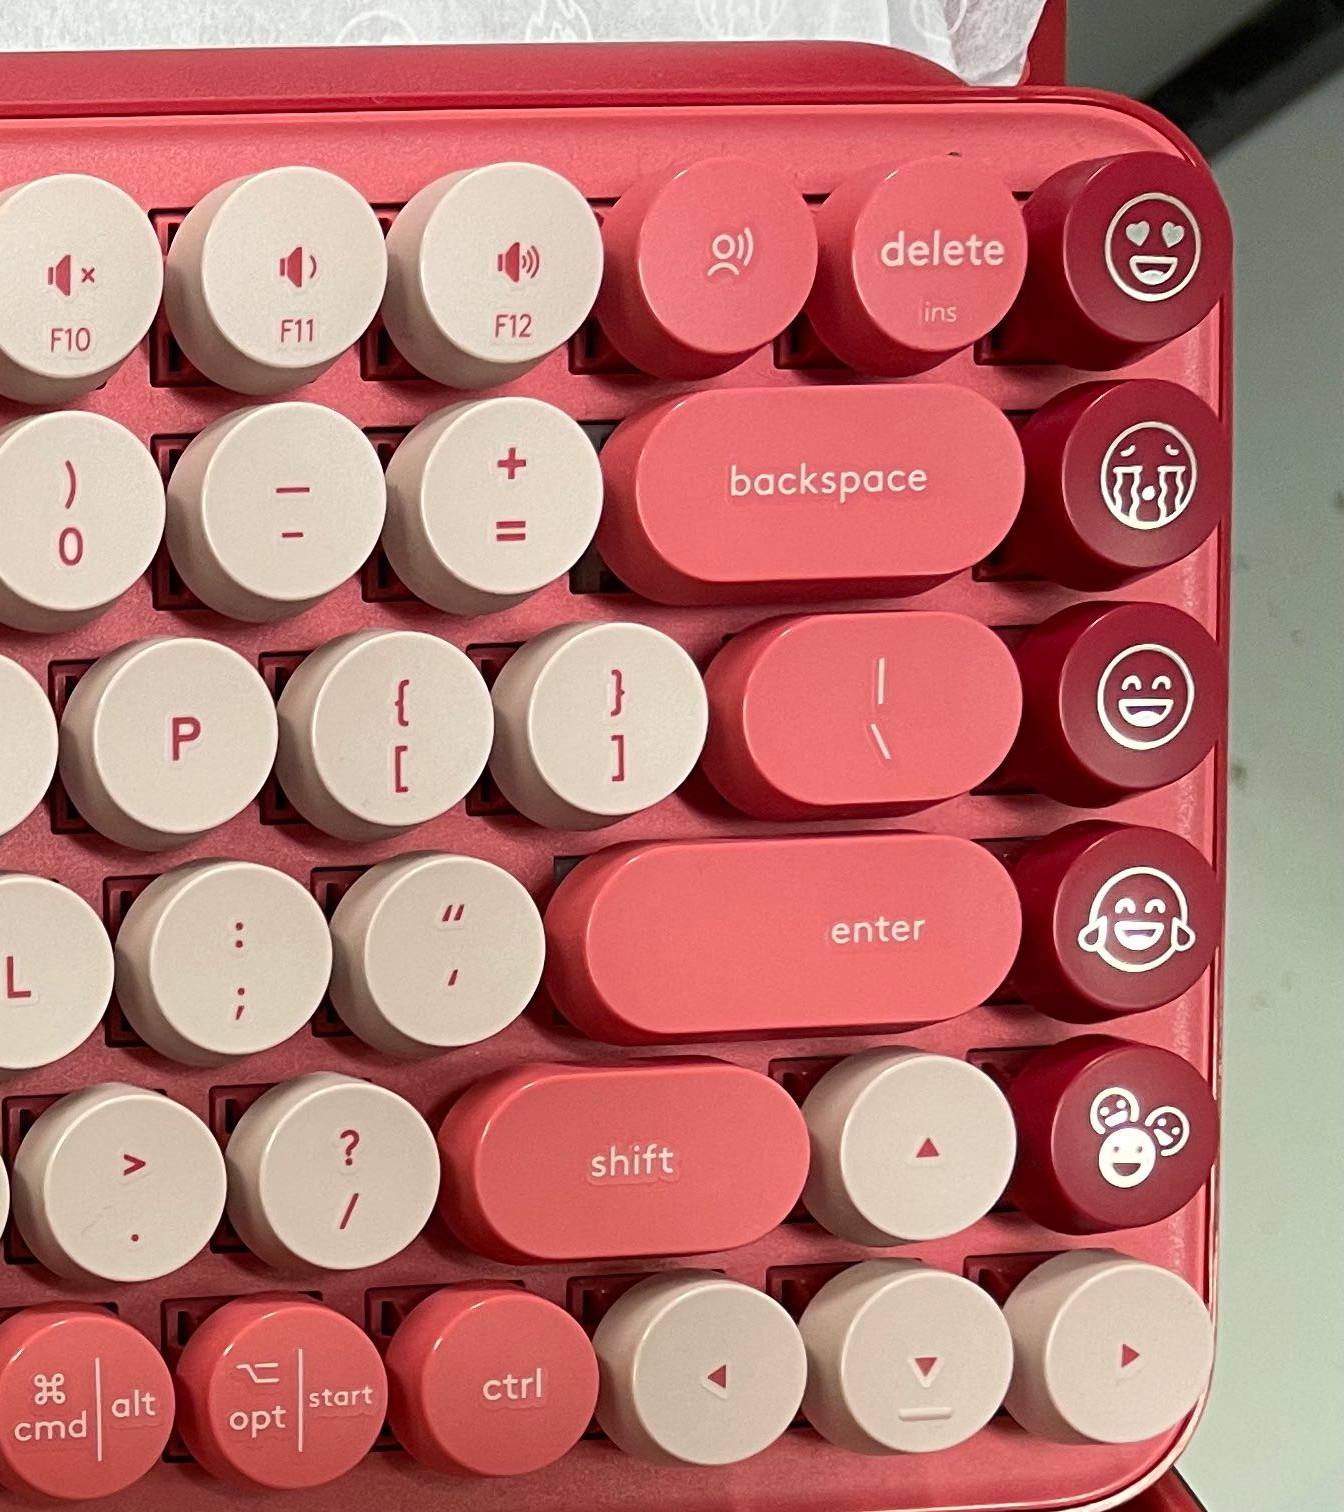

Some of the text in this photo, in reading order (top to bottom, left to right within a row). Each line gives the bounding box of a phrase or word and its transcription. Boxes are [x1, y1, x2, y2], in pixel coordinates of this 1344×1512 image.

[880, 229, 1005, 267] delete
[280, 318, 314, 343] F11
[494, 313, 532, 338] F12
[925, 301, 957, 322] ins
[50, 327, 91, 353] F10
[496, 447, 527, 480] +
[64, 459, 77, 510] )
[730, 462, 928, 504] backspace
[495, 520, 527, 542] =
[394, 679, 410, 728] {
[610, 668, 626, 717] }
[171, 716, 202, 762] P
[394, 745, 409, 794] [
[610, 734, 625, 783] ]
[831, 915, 926, 945] enter
[6, 955, 32, 999] L
[123, 1153, 147, 1176] >
[339, 1129, 360, 1167] ?
[591, 1143, 674, 1178] shift
[339, 1192, 360, 1230] /
[482, 1367, 542, 1401] ctrl
[14, 1389, 156, 1442] cmd alt
[229, 1385, 373, 1438] opt start
